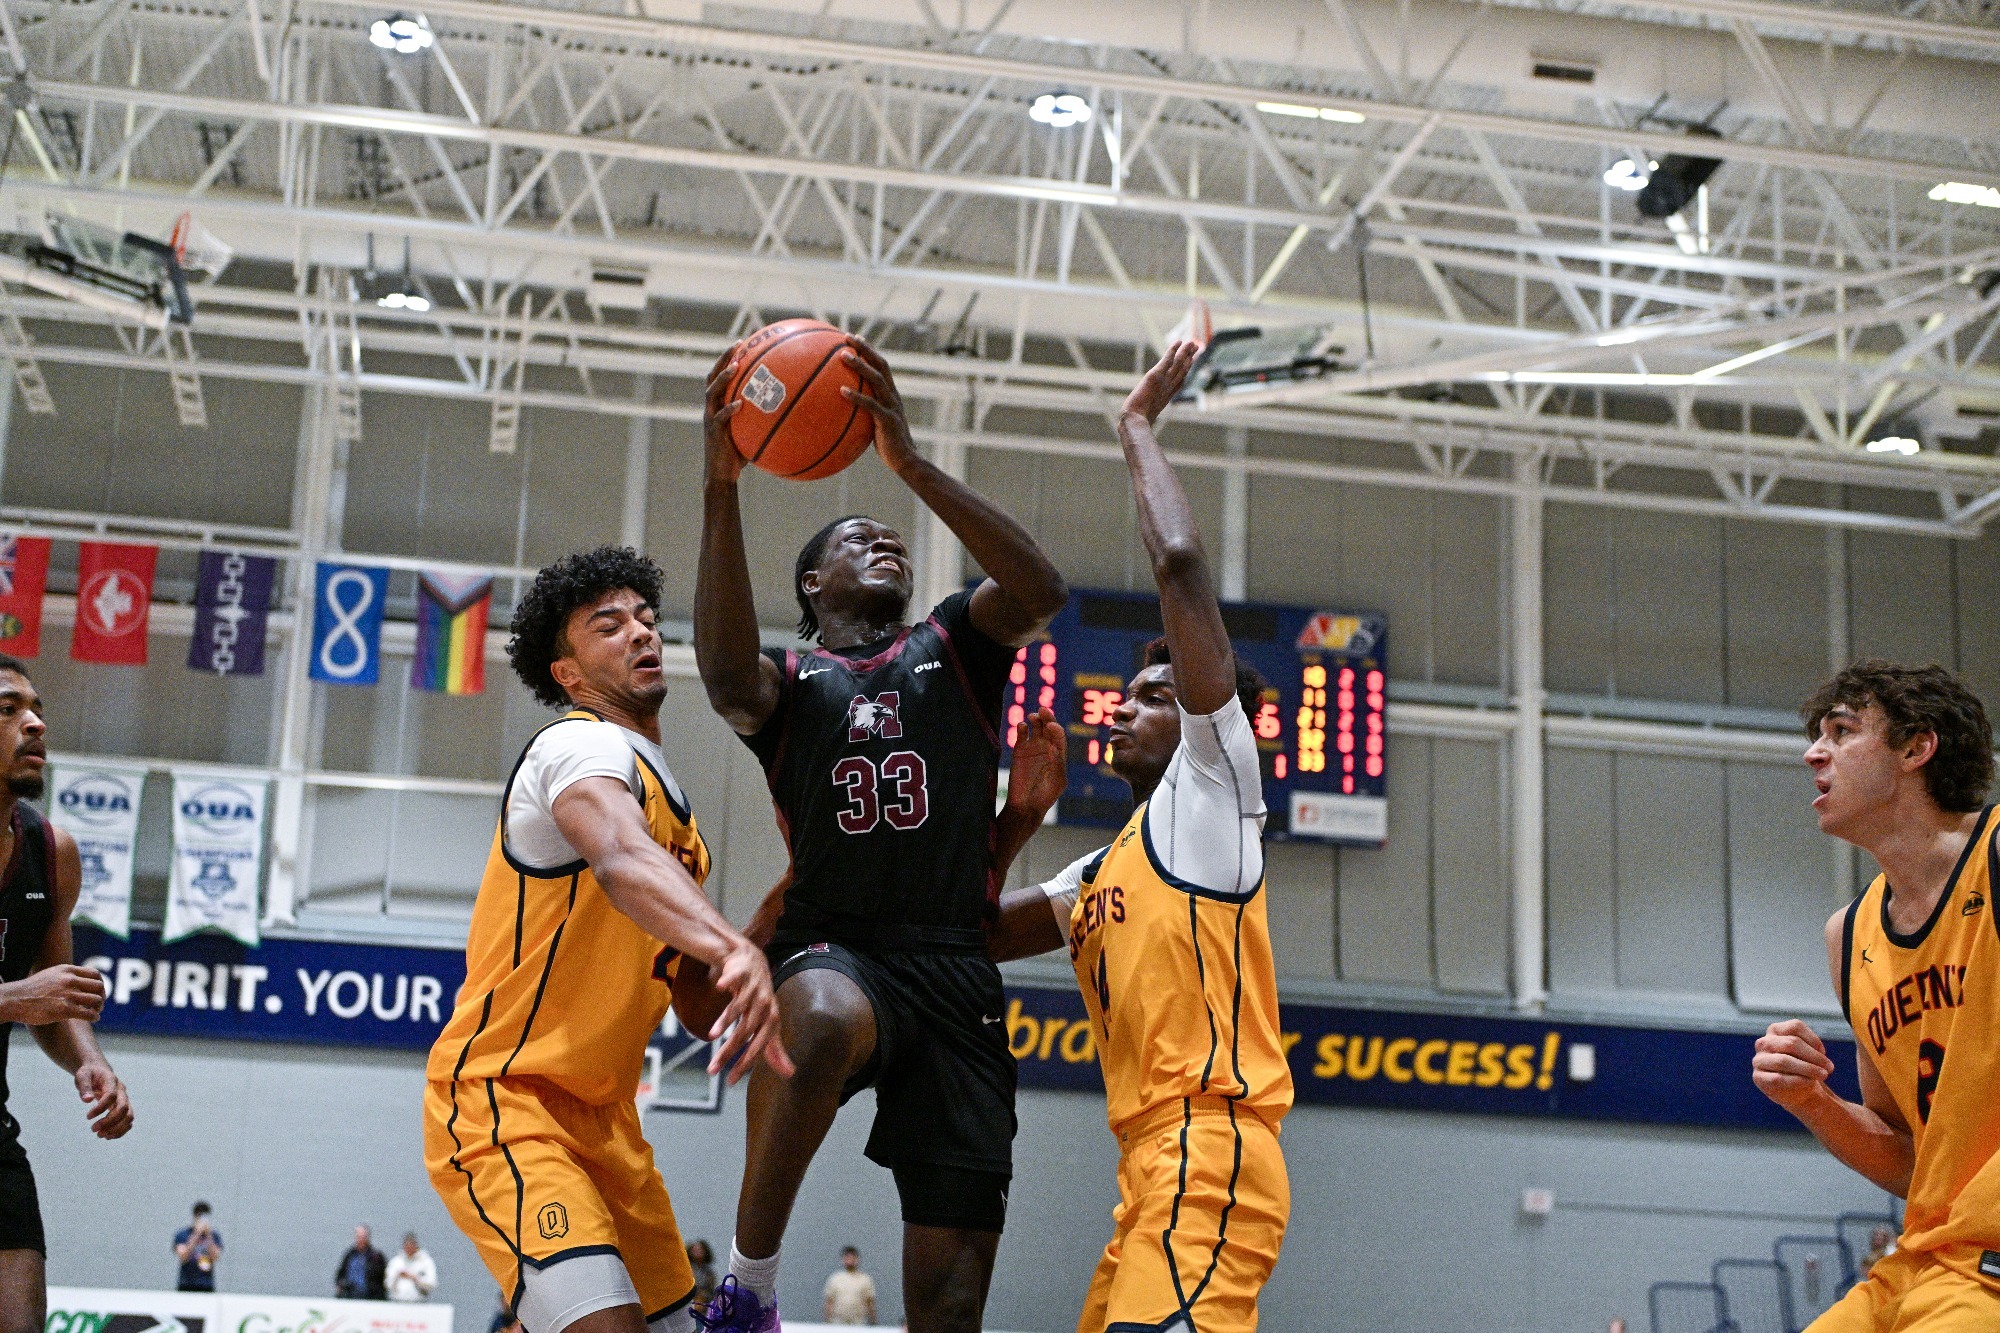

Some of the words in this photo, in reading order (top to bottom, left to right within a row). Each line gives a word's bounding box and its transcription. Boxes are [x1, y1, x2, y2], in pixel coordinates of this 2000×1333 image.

[914, 661, 942, 674] OUA
[59, 790, 131, 812] OUA
[832, 751, 929, 834] 33
[182, 802, 255, 821] OUA
[25, 892, 45, 900] OUA
[297, 968, 442, 1023] YOUR
[1312, 1032, 1561, 1091] SUCCESS!
[537, 1202, 569, 1240] Q
